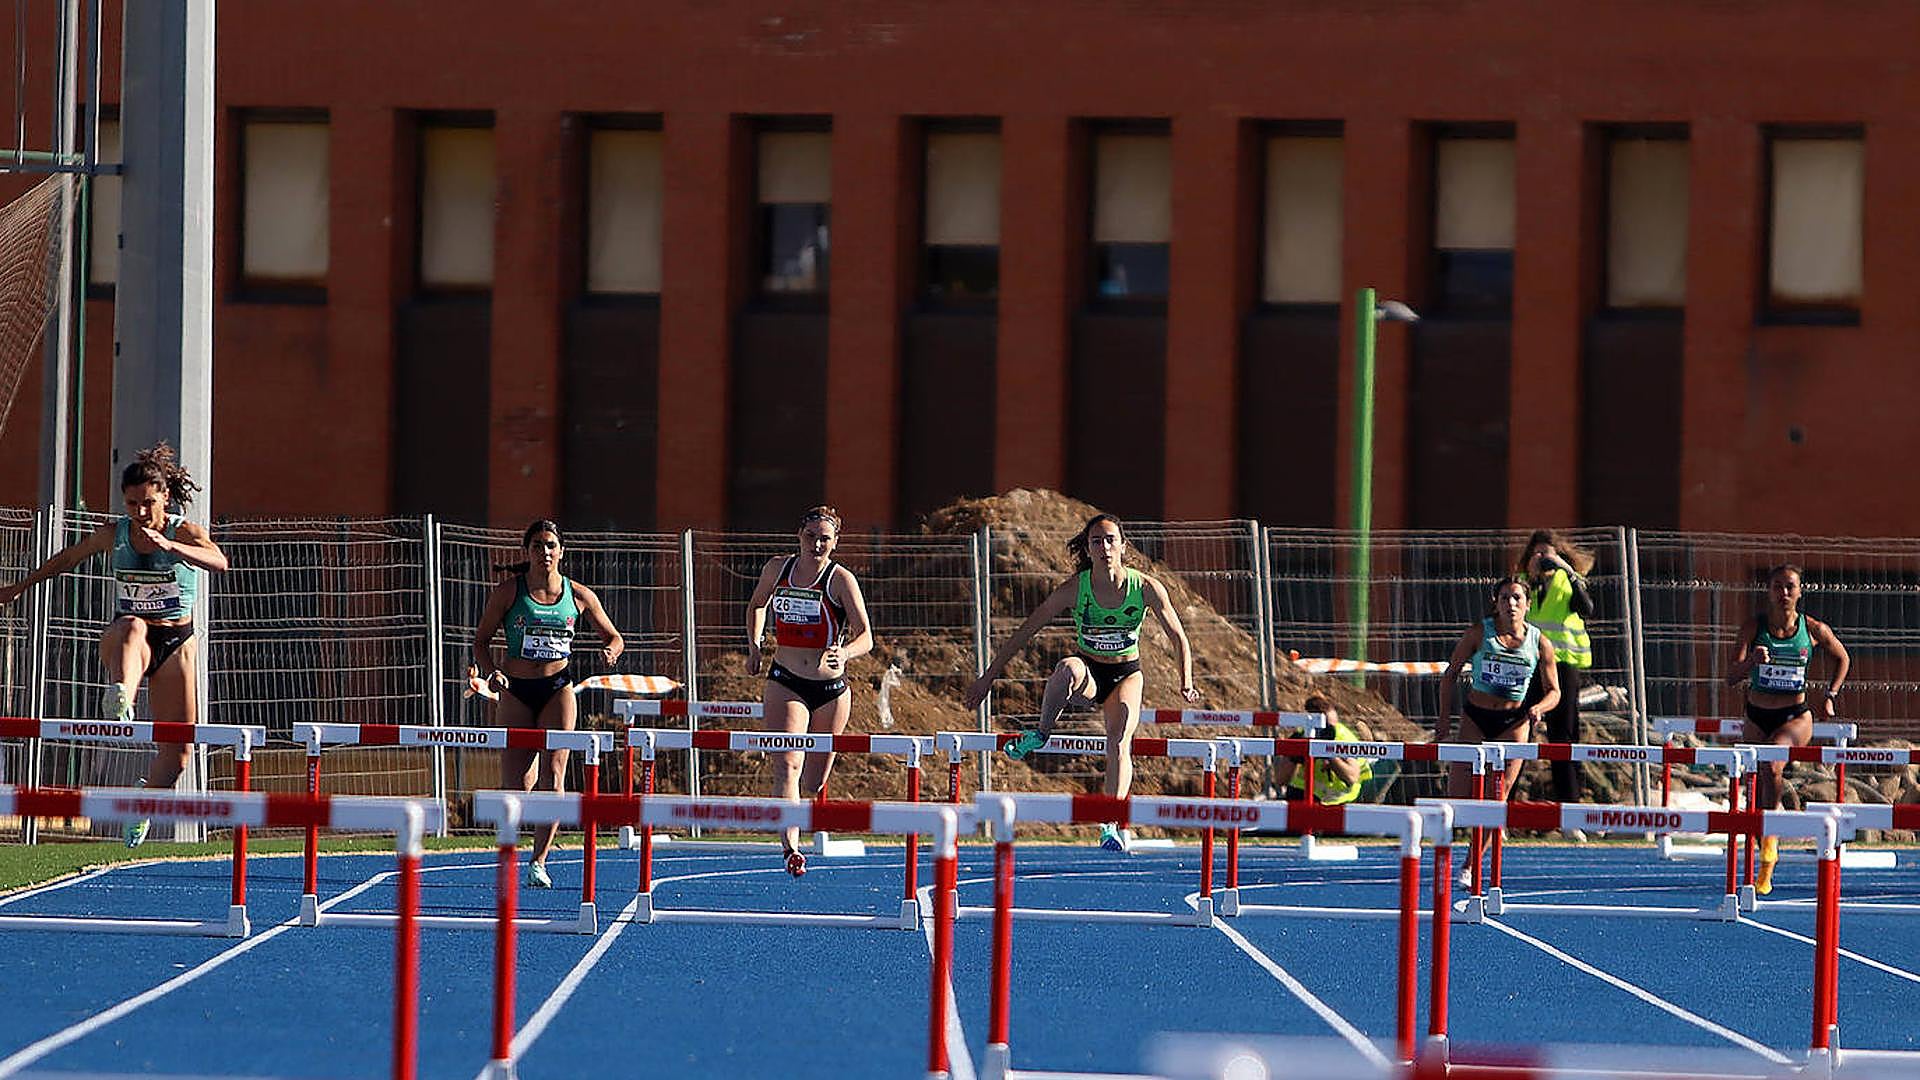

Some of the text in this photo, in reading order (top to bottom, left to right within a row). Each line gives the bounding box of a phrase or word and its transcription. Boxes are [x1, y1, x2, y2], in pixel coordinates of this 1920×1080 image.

[123, 584, 140, 598] 17
[776, 598, 791, 612] 26
[532, 637, 541, 648] 3
[1487, 662, 1501, 674] 18
[710, 704, 752, 716] MONDO
[1201, 712, 1241, 723] MONDO
[72, 723, 134, 738] MONDO
[428, 730, 488, 744] MONDO
[760, 736, 815, 749] MONDO
[1061, 738, 1105, 751] MOND
[1335, 743, 1387, 756] MONDO
[1598, 747, 1647, 760] MONDO
[1846, 749, 1894, 762] MONDO
[131, 799, 233, 818] MONDO
[687, 804, 782, 823] MONDO
[1173, 803, 1261, 822] MONDO
[1603, 810, 1682, 828] MONDO
